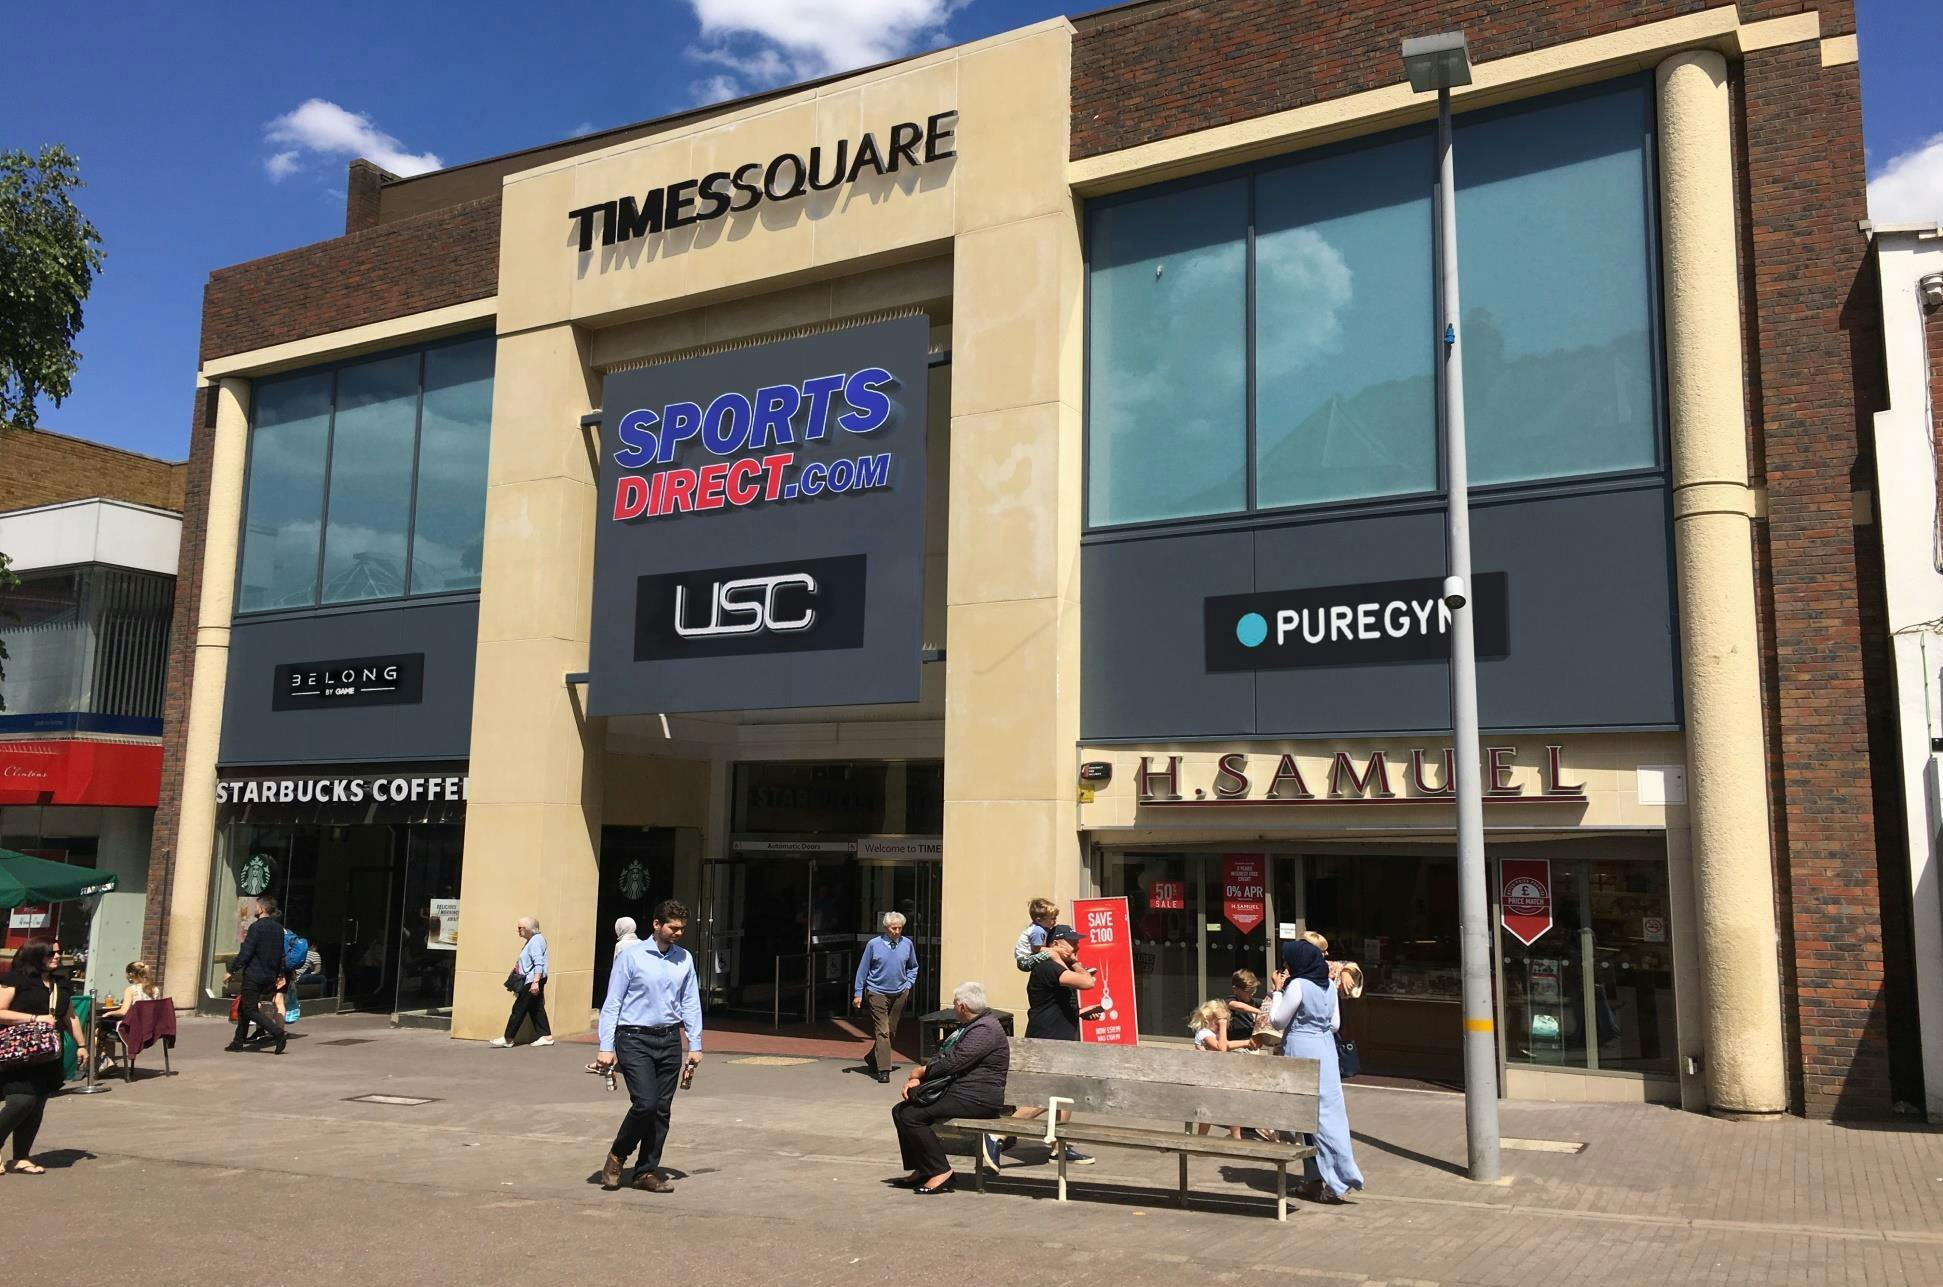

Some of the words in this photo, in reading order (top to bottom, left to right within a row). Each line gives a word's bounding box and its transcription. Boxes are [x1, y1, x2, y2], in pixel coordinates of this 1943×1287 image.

[613, 367, 893, 468] SPORTS
[613, 453, 892, 521] DIRECT.COM
[675, 573, 817, 638] USC
[325, 688, 334, 696] BY
[335, 687, 355, 695] GAME
[4, 765, 48, 778] Clintons
[215, 778, 364, 804] STARBUCKS
[767, 842, 801, 850] Automatic
[801, 842, 821, 850] Doors
[865, 843, 906, 854] Welcome
[907, 844, 916, 854] to
[1226, 885, 1242, 898] 0%
[1244, 886, 1264, 898] APR
[1155, 900, 1177, 909] SALE
[1508, 897, 1525, 905] PRICE
[1525, 898, 1544, 906] MATCH
[1088, 911, 1113, 927] SAVE
[1090, 928, 1113, 943] £100
